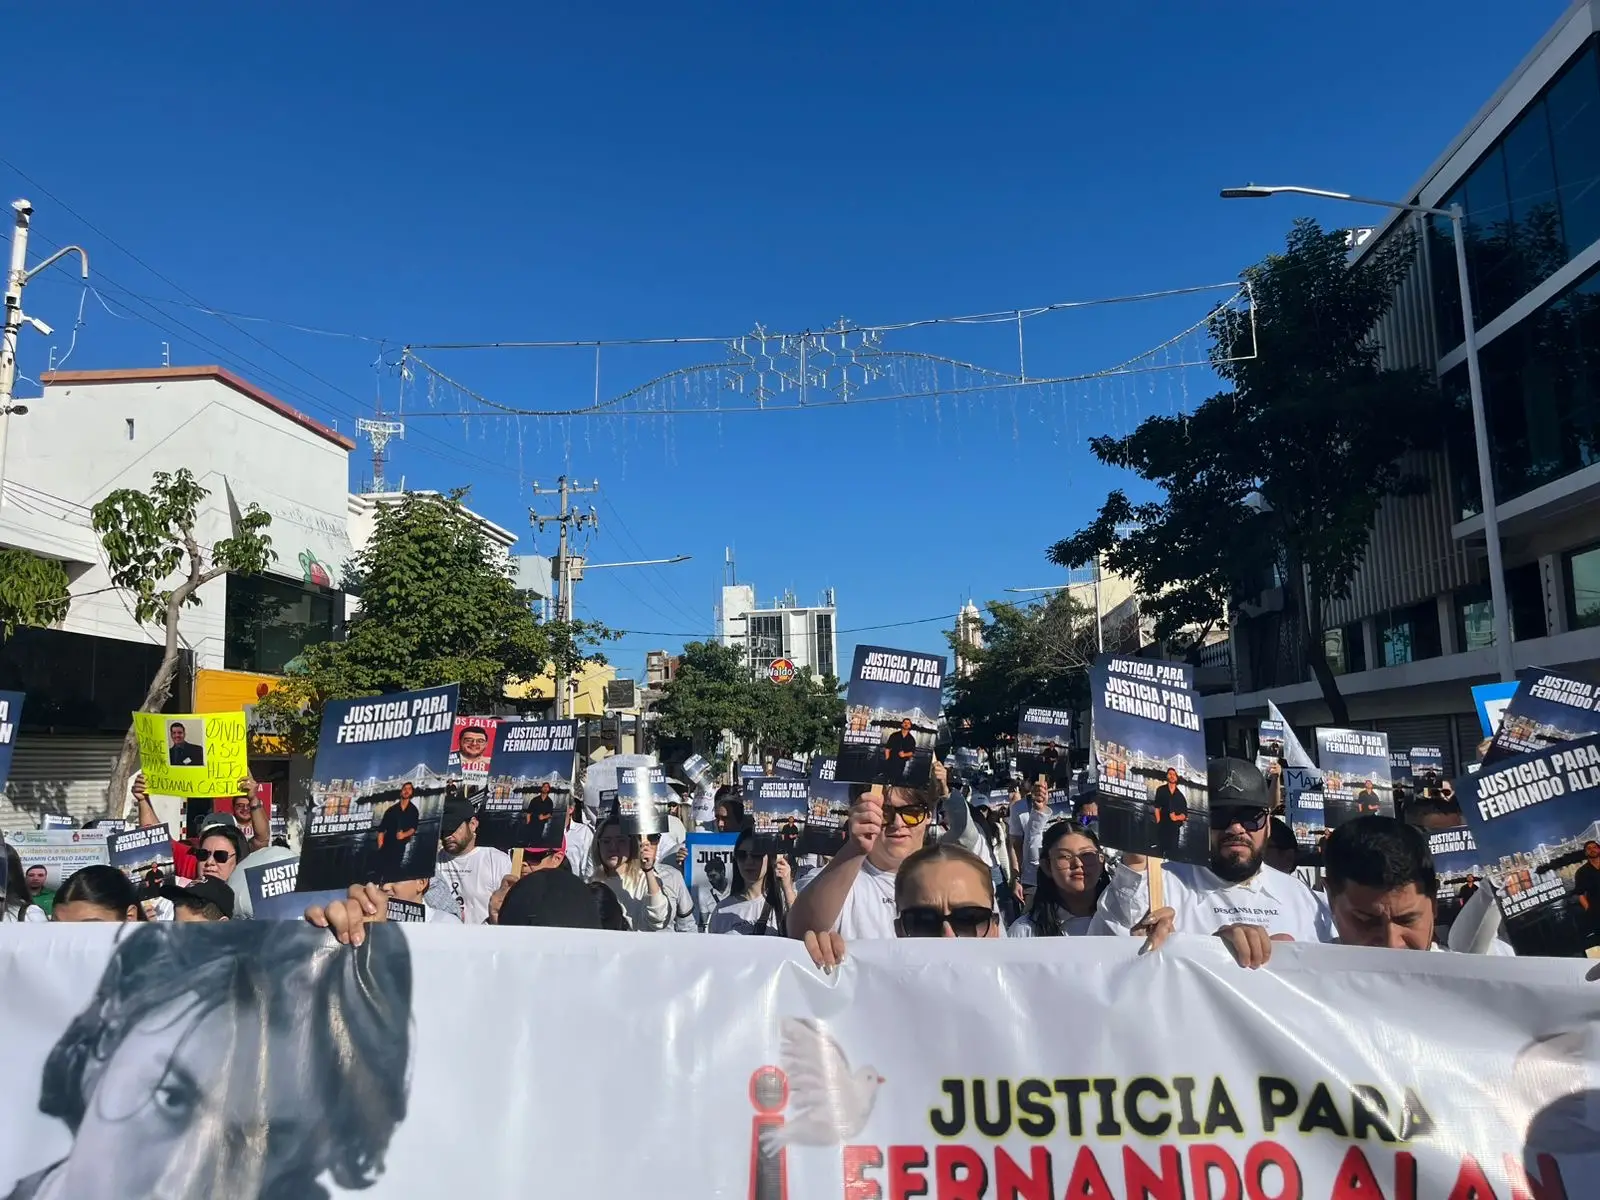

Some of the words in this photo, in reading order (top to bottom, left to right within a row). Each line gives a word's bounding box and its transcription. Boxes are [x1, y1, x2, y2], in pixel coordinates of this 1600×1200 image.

[865, 652, 907, 670] JUSTICIA
[910, 658, 938, 674] PARA
[1108, 659, 1153, 678] JUSTICIA
[1156, 666, 1184, 681] PARA
[860, 666, 910, 684] FERNANDO
[912, 672, 941, 688] ALAN
[1106, 676, 1160, 704] JUSTICIA
[1162, 691, 1194, 712] PARA
[1538, 675, 1591, 697] JUSTICIA
[1529, 684, 1593, 710] FERNANDO
[344, 700, 407, 724] JUSTICIA
[412, 694, 448, 718] PARA
[1026, 708, 1050, 716] JUSTICIA
[1052, 711, 1067, 719] PARA
[1104, 692, 1166, 722] FERNANDO
[1170, 708, 1200, 732] ALAN
[337, 719, 412, 743] FERNANDO
[415, 712, 452, 735] ALAN
[470, 718, 497, 728] FALTA
[1024, 714, 1052, 724] FERNANDO
[1054, 717, 1068, 726] ALAN
[508, 726, 548, 739] JUSTICIA
[550, 725, 572, 738] PARA
[1328, 733, 1360, 744] JUSTICIA
[1362, 735, 1382, 746] PARA
[207, 744, 215, 756] A
[220, 744, 240, 758] SU
[503, 739, 550, 752] FERNANDO
[552, 738, 574, 750] ALAN
[1326, 741, 1364, 755] FERNANDO
[1366, 746, 1386, 757] ALAN
[208, 761, 242, 779] HIJO
[1476, 758, 1550, 799] JUSTICIA
[1550, 744, 1600, 774] PARA
[760, 790, 790, 798] FERNANDO
[791, 790, 806, 798] ALAN
[761, 782, 788, 790] JUSTICIA
[1300, 792, 1323, 802] JUSTICIA
[1478, 776, 1564, 821] FERNANDO
[116, 831, 146, 844] JUSTICIA
[147, 827, 164, 837] PARA
[311, 825, 318, 834] 13
[1428, 831, 1461, 844] JUSTICIA
[116, 840, 150, 852] FERNANDO
[151, 834, 168, 844] ALAN
[1429, 840, 1465, 854] ERNANDO
[405, 904, 421, 916] PARA
[927, 1075, 1246, 1139] JUSTICIA
[1256, 1074, 1438, 1143] PARA
[842, 1140, 1304, 1200] FERNANDO
[1328, 1144, 1569, 1200] ALAN
